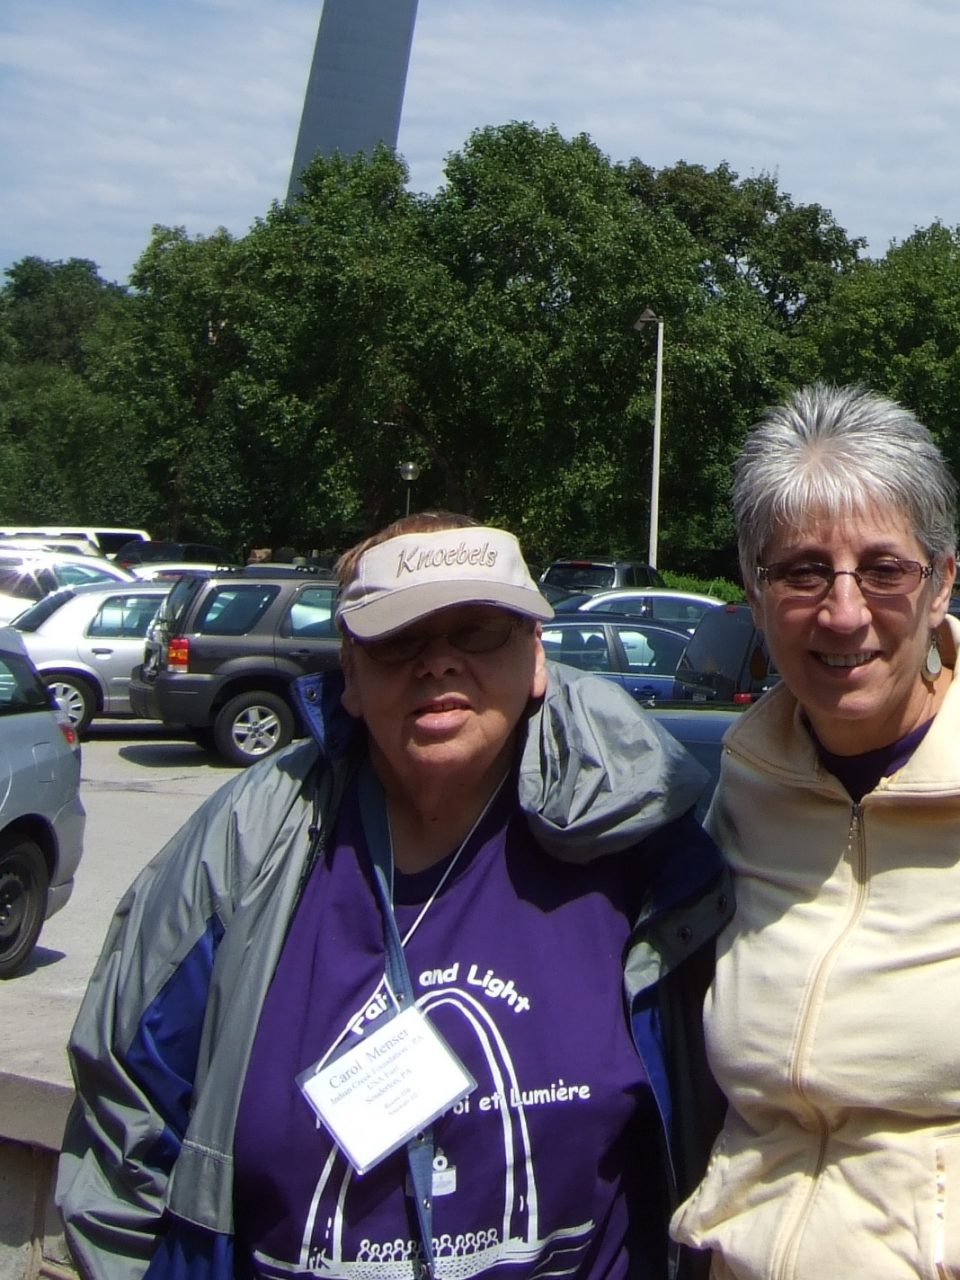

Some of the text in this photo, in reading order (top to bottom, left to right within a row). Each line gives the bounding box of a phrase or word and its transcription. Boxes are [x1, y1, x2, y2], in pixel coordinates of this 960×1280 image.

[396, 541, 499, 578] Knoebels
[419, 962, 459, 986] and
[467, 965, 531, 1014] Light
[328, 1027, 409, 1089] Carol Menser
[479, 1094, 502, 1111] et
[510, 1079, 591, 1107] Lumière
